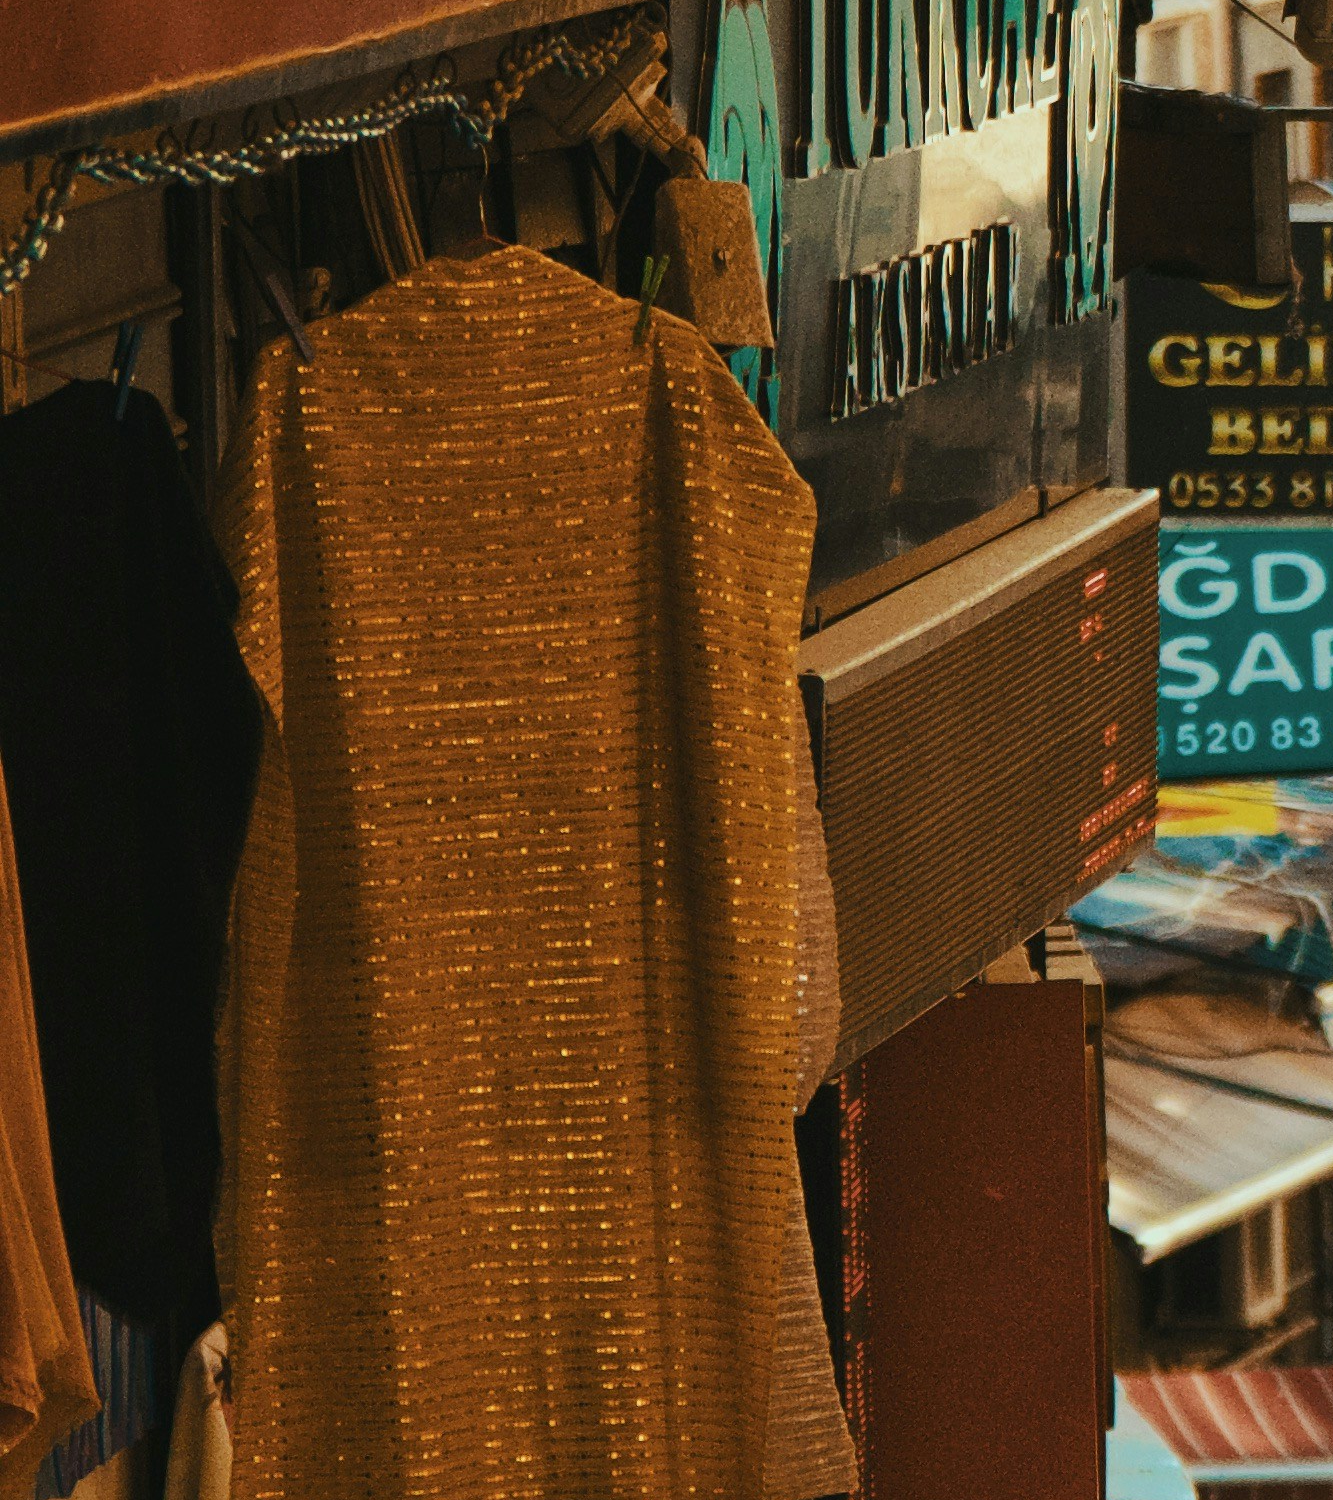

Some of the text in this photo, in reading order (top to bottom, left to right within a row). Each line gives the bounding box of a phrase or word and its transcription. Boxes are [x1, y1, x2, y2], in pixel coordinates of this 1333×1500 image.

[836, 222, 1022, 421] AKSESUAR
[1169, 470, 1275, 509] 0533
[1176, 718, 1256, 756] 520
[1270, 715, 1322, 750] 83
